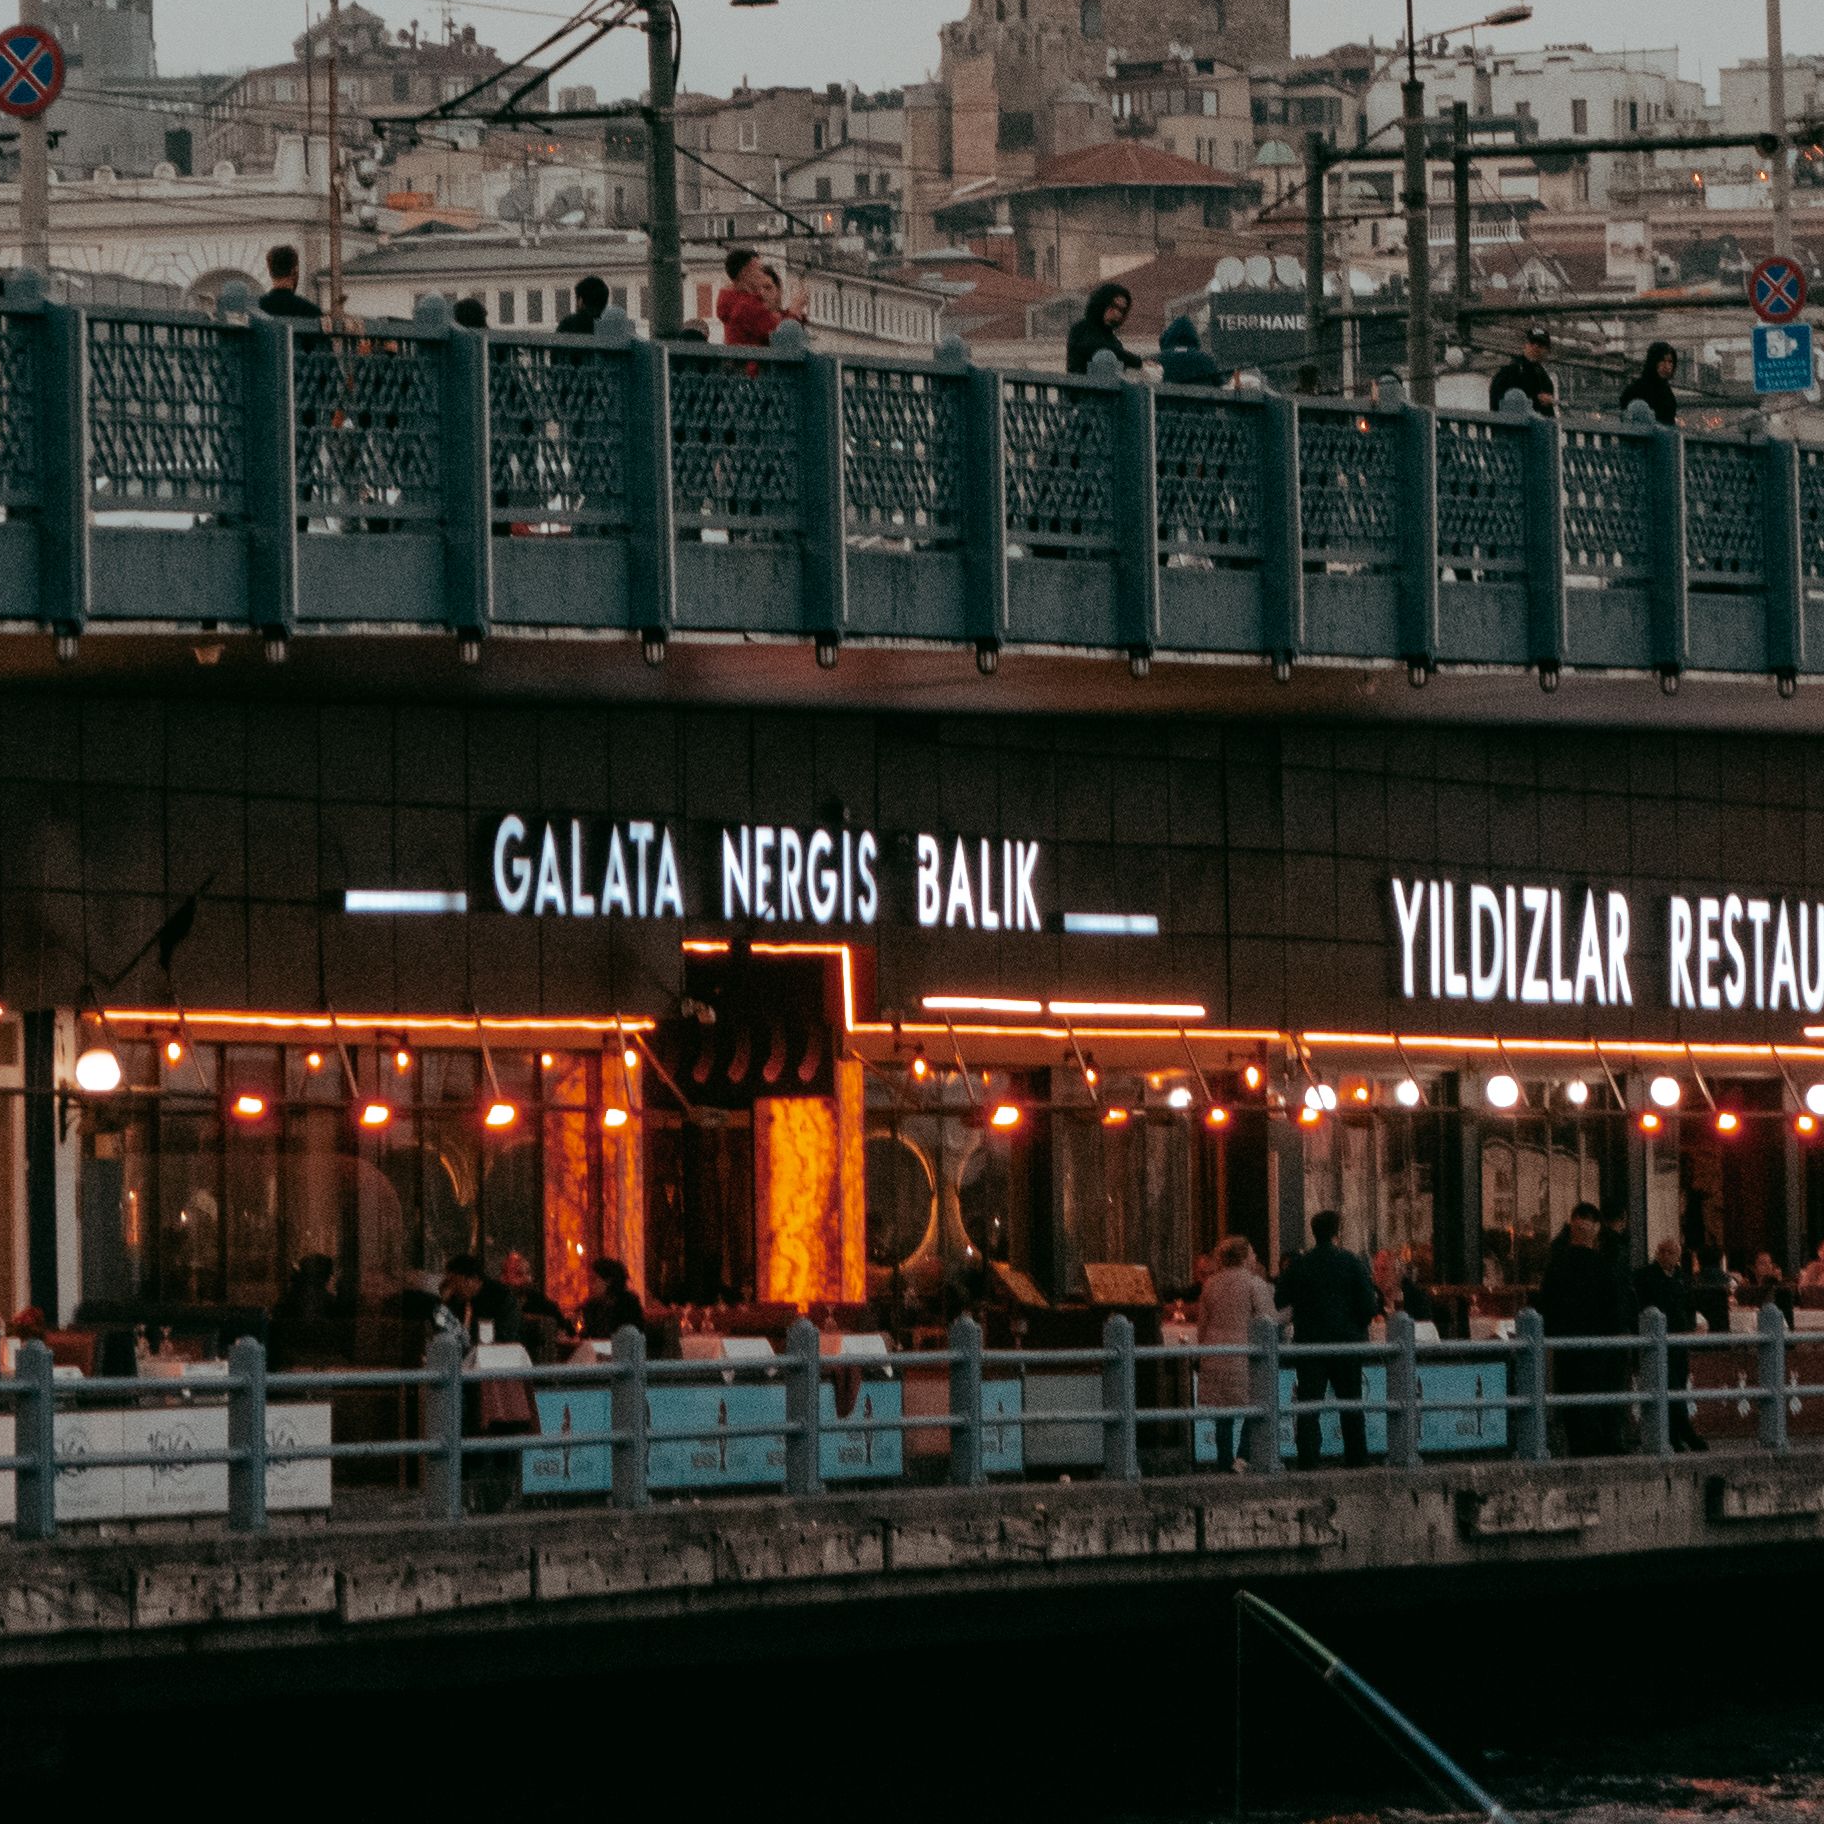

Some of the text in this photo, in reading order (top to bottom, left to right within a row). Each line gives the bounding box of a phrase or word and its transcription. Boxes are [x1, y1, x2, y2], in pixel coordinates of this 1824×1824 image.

[493, 813, 685, 918] GALATA
[916, 832, 1043, 932] BALIK
[1391, 876, 1634, 1006] YILDIZLAR
